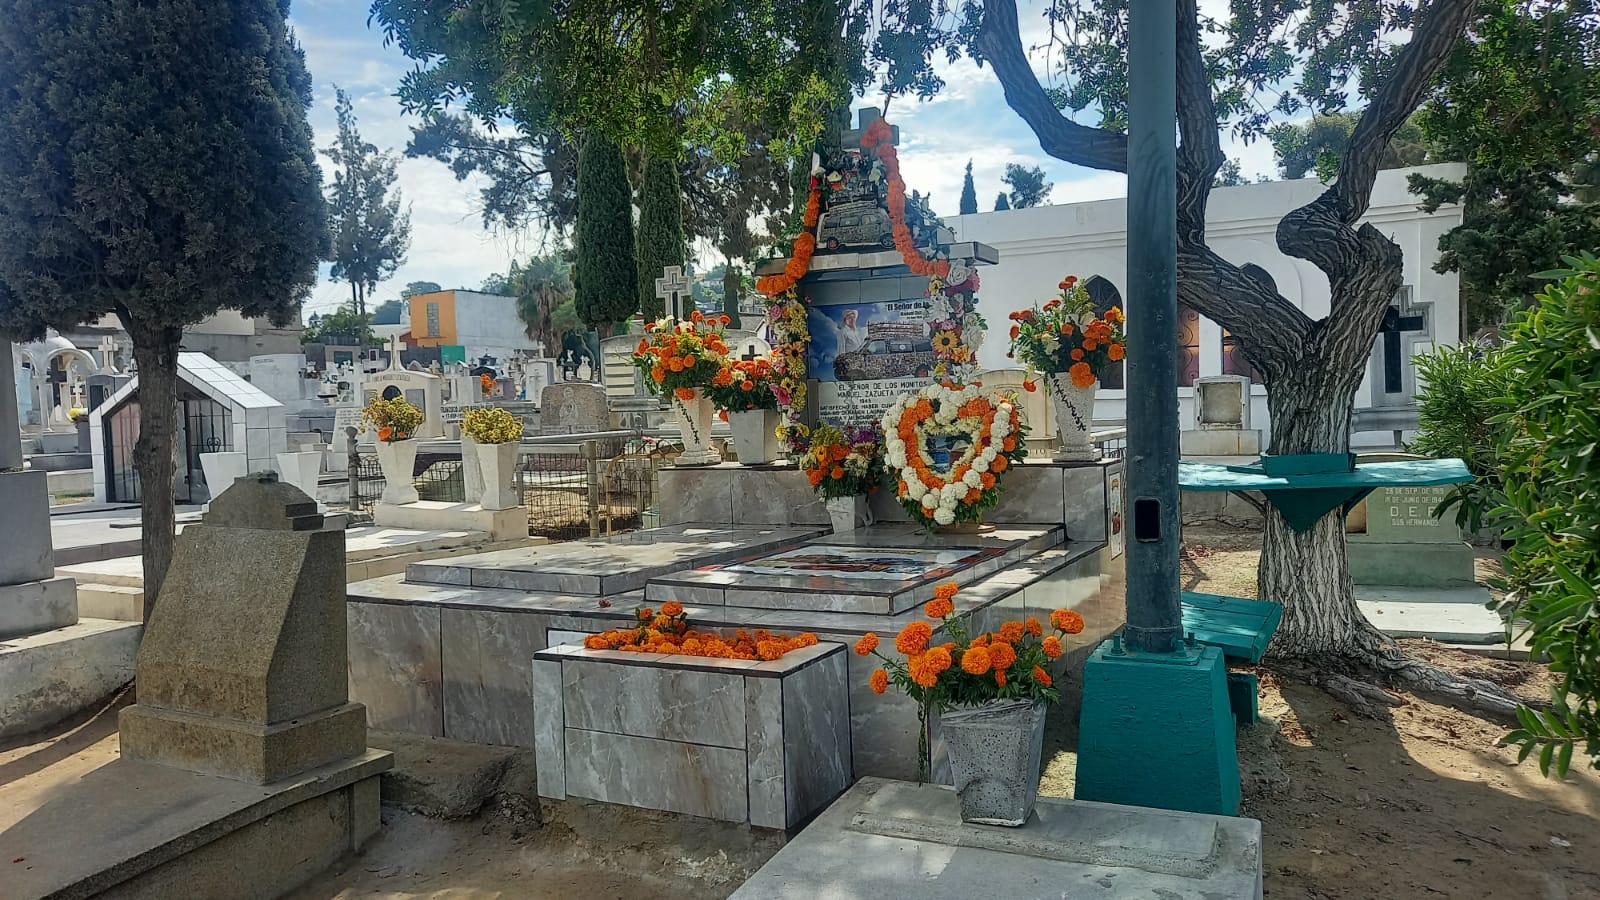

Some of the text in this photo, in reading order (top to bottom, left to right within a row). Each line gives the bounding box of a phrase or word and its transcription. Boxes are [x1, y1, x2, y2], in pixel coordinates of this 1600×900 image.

[894, 302, 913, 310] Señor
[914, 301, 922, 309] de
[874, 382, 882, 390] DE
[865, 389, 894, 398] ZAZUETA
[1395, 487, 1403, 495] DE
[1421, 487, 1431, 495] DE
[1392, 496, 1401, 504] DE
[1421, 496, 1431, 504] DE
